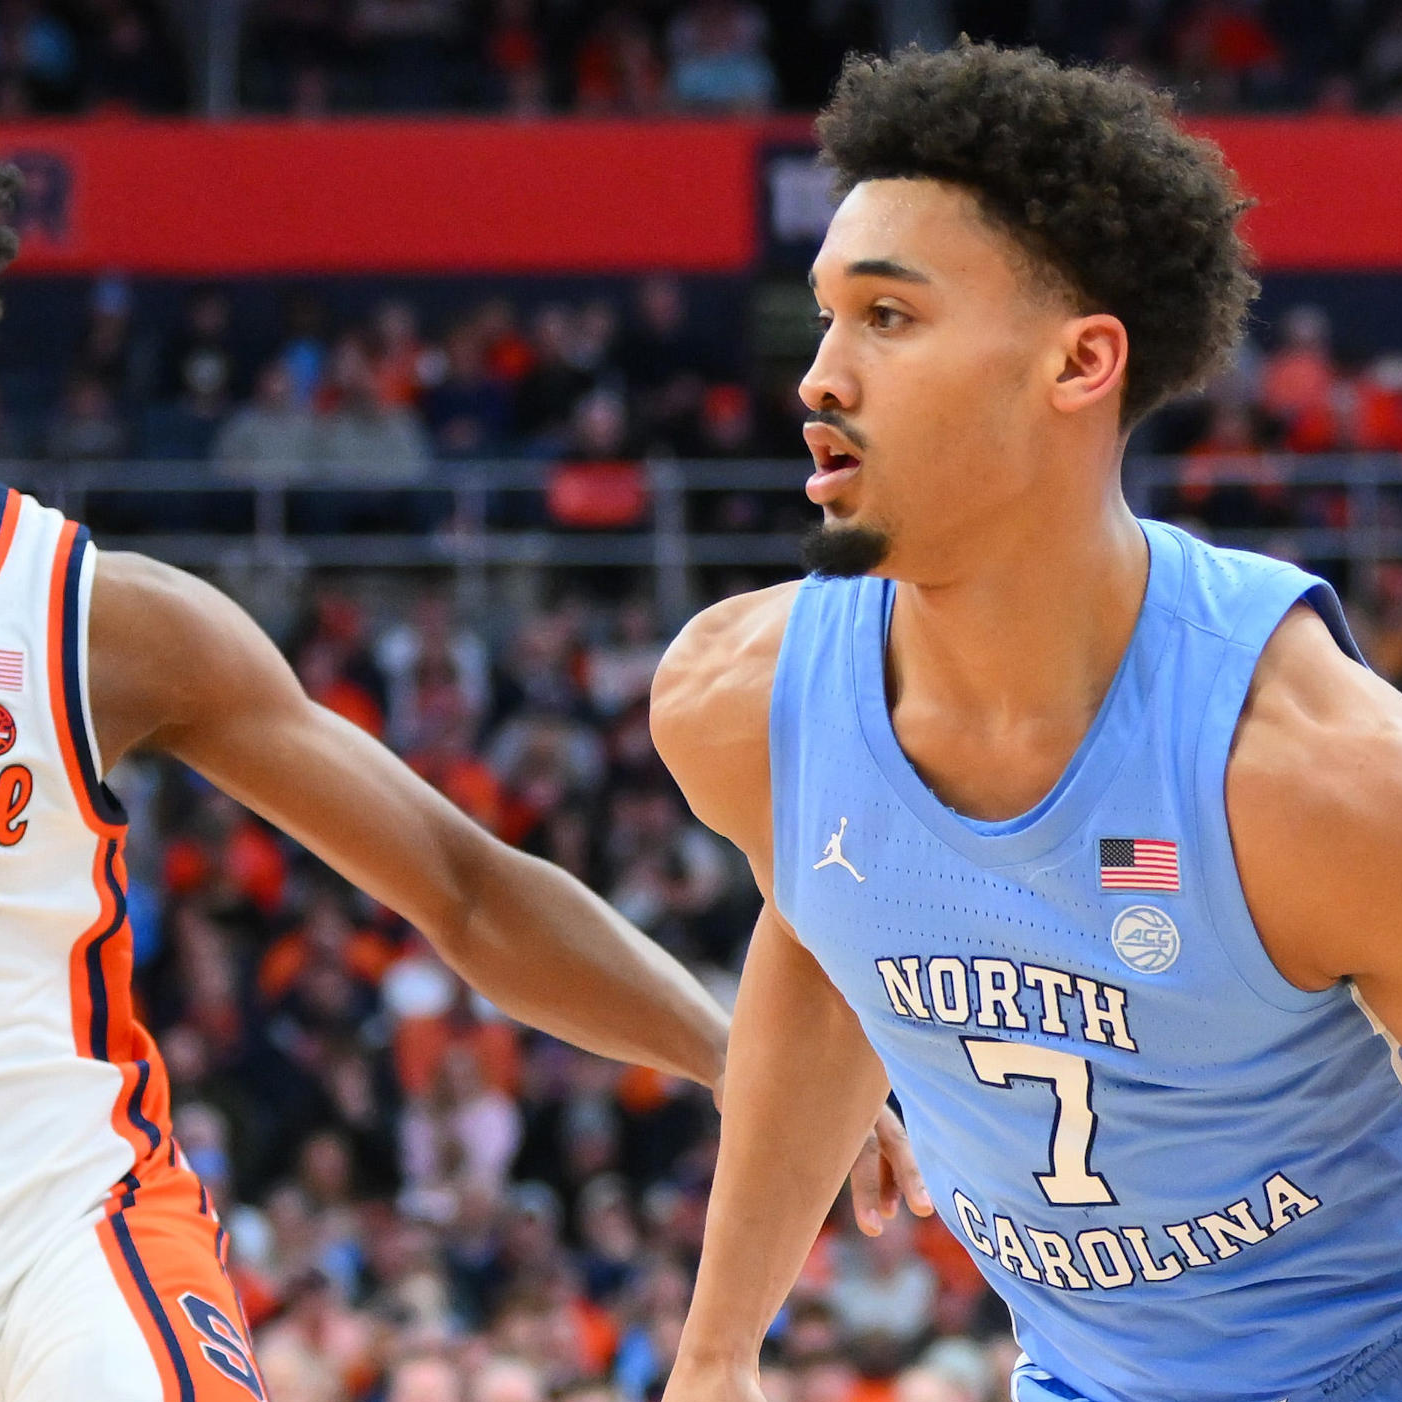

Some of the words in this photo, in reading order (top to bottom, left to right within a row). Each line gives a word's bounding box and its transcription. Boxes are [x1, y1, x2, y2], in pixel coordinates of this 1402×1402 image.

[1124, 927, 1172, 943] ACC
[875, 956, 1139, 1053] NORTH
[959, 1035, 1120, 1206] 7
[952, 1172, 1323, 1291] CAROLINA
